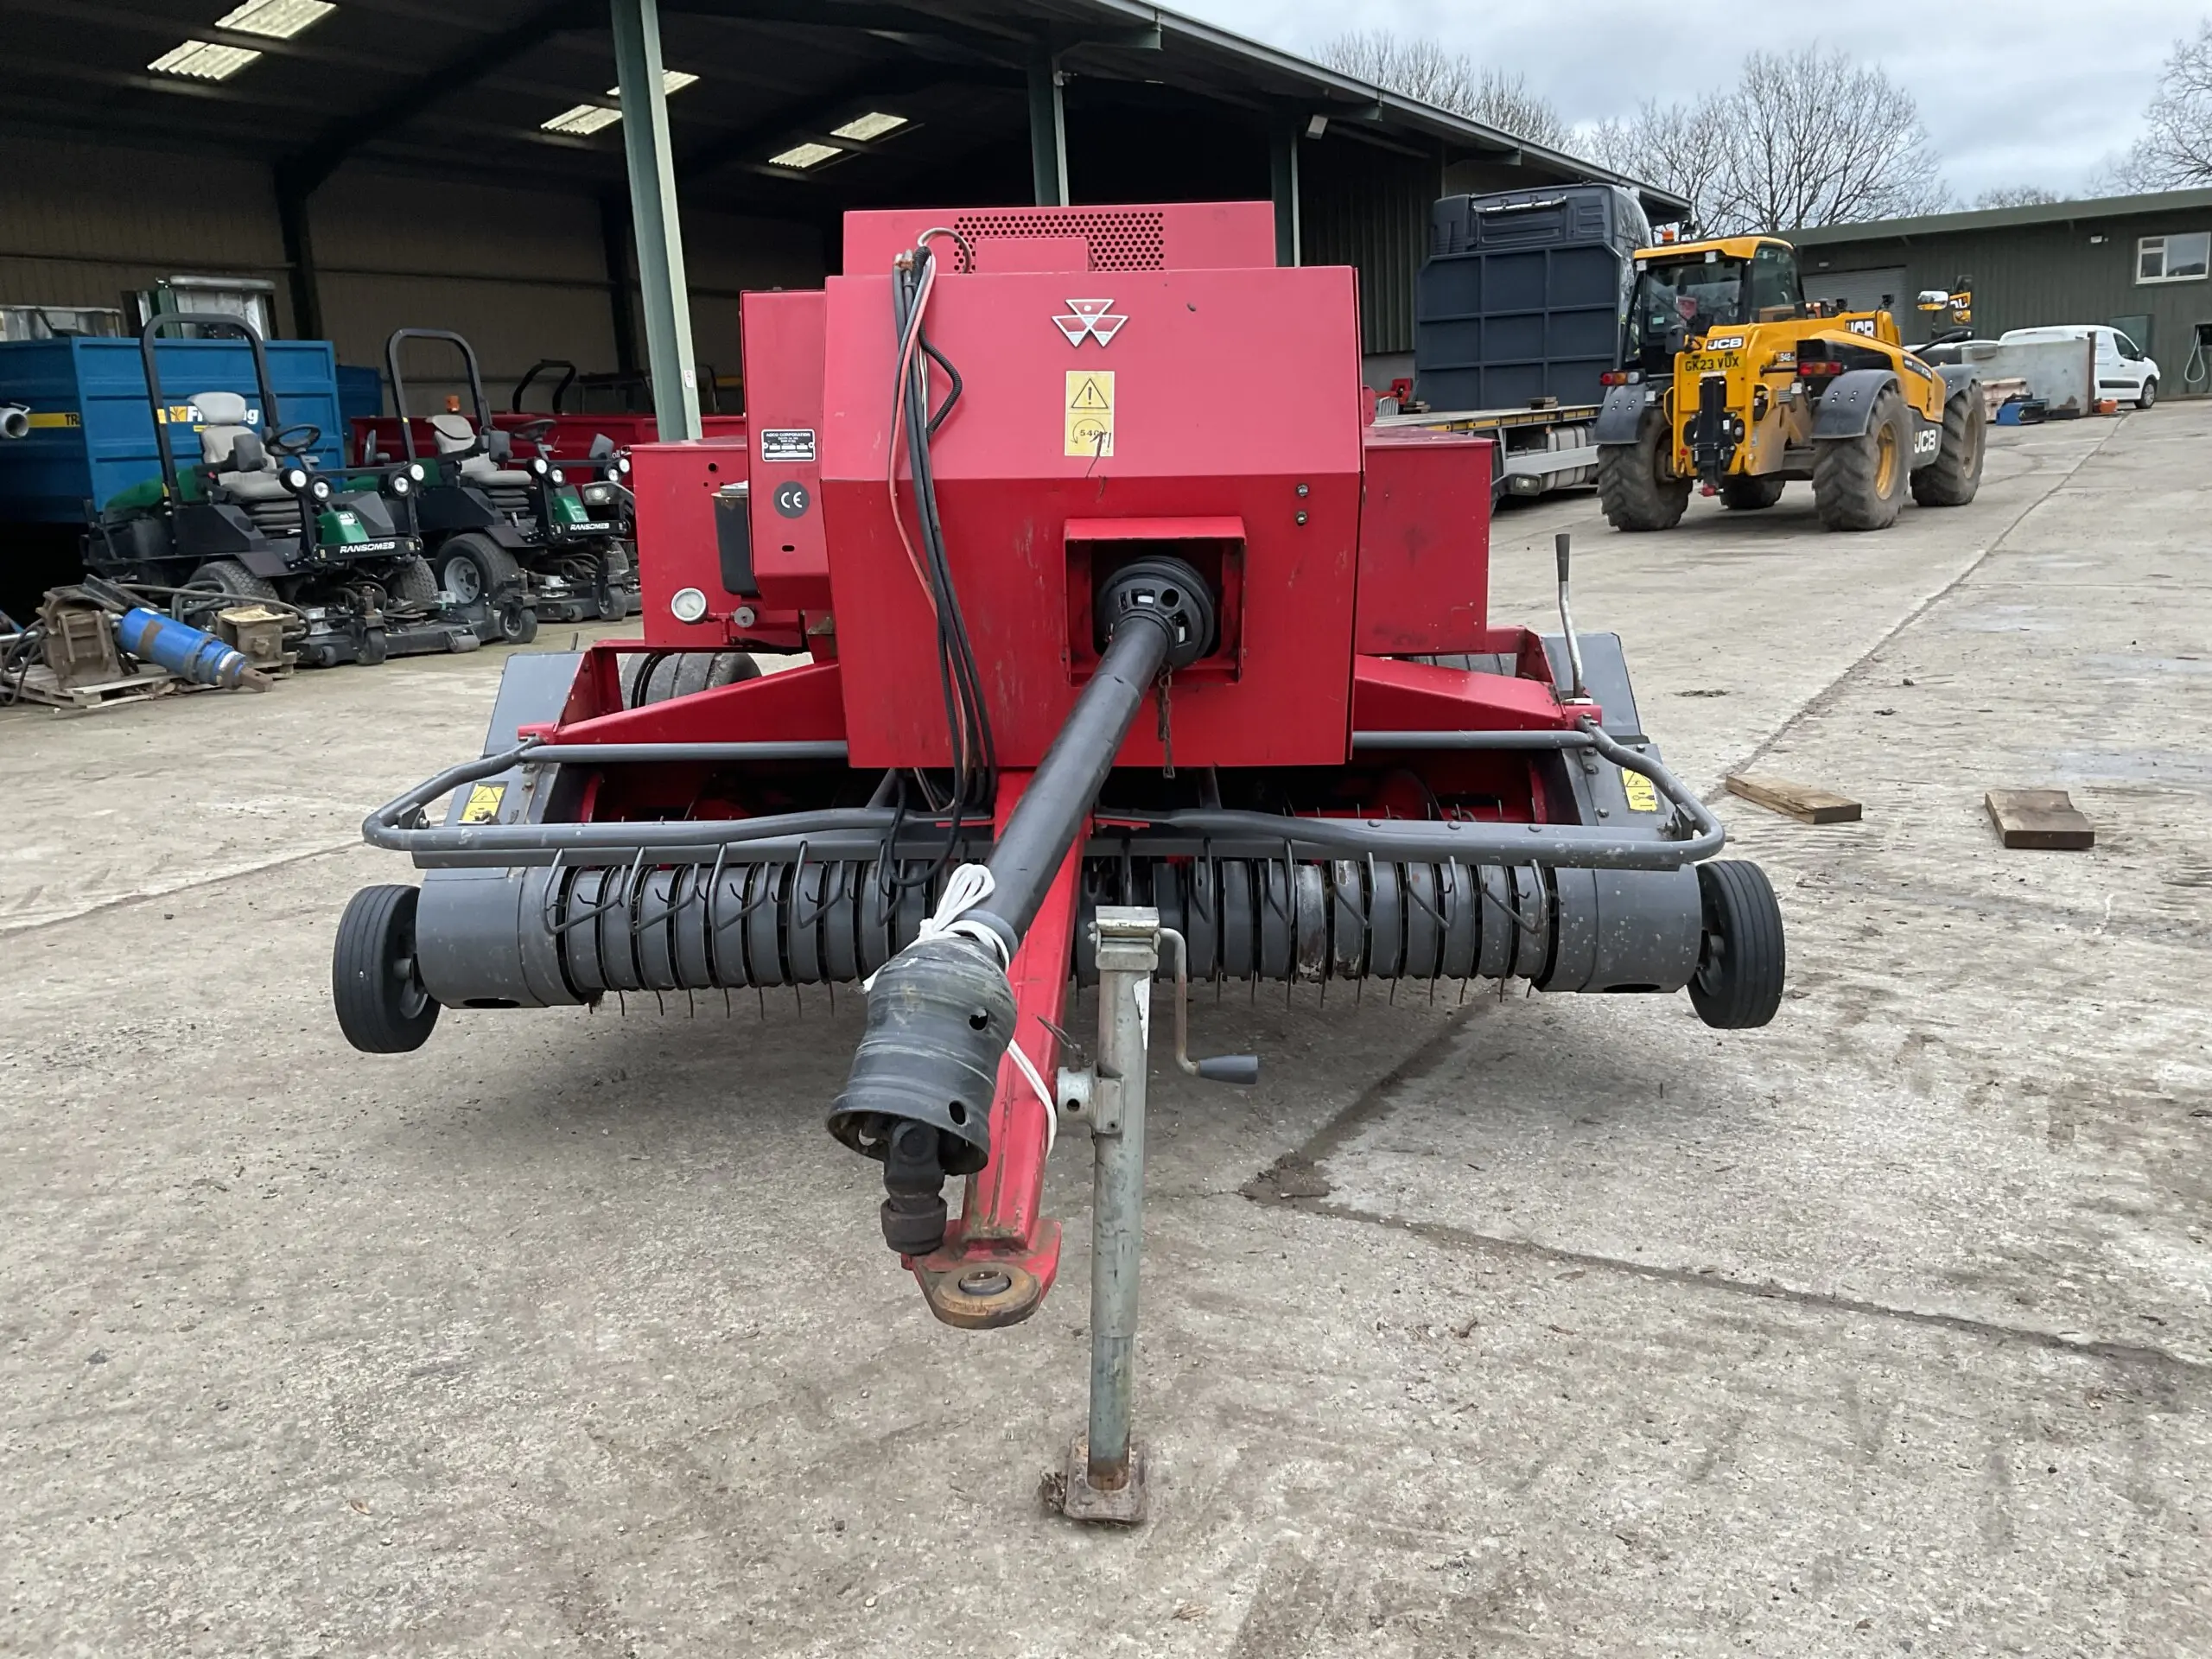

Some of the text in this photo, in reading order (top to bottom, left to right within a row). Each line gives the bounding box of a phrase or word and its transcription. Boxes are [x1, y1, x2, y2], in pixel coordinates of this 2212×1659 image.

[1707, 337, 1744, 351] JCB
[1685, 356, 1739, 372] GK23 VUX
[1914, 429, 1936, 454] JCB
[780, 491, 803, 509] CE
[570, 522, 610, 531] RANSOMES
[340, 541, 396, 554] RANSOMES
